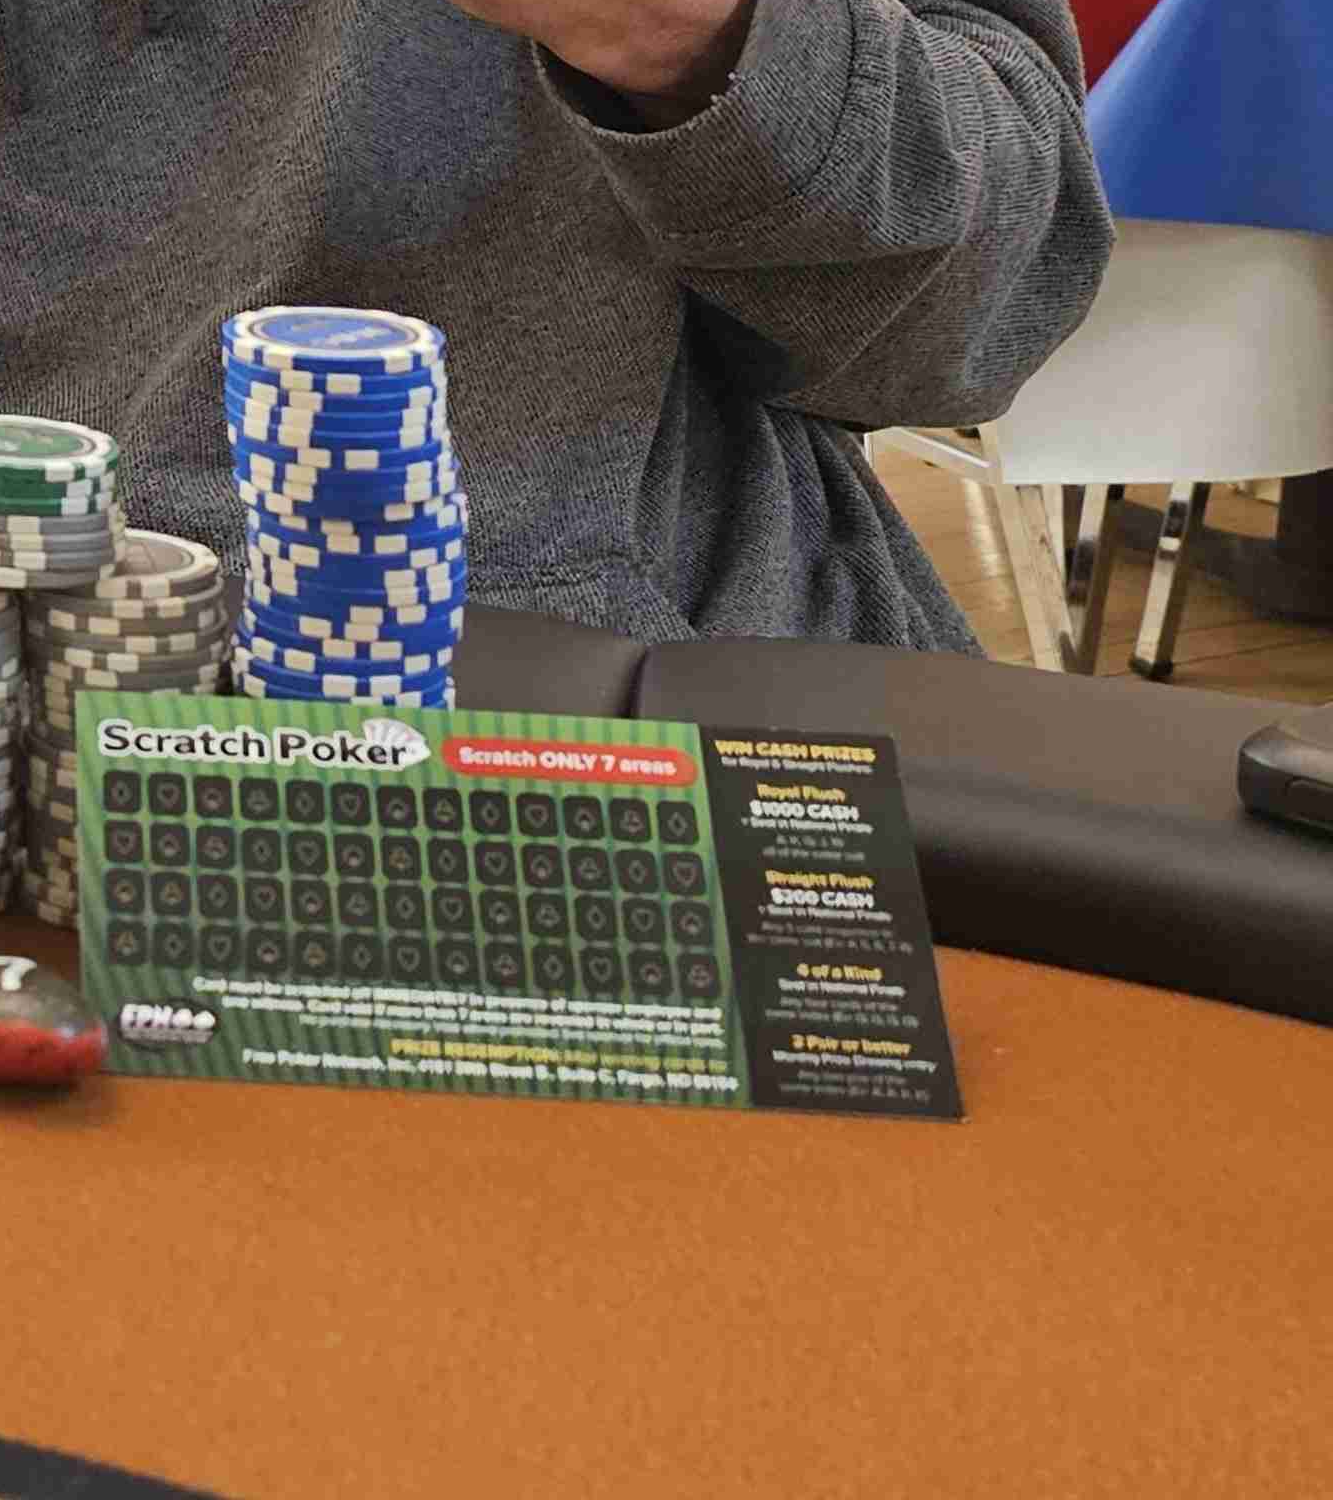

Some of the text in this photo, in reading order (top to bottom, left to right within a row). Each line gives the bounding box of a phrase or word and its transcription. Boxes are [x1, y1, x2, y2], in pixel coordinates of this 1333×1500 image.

[102, 723, 407, 765] Scratch Poker
[755, 741, 809, 759] CASH
[459, 746, 678, 776] Scratch ONLY 7 areas
[807, 803, 860, 821] CASH
[821, 890, 875, 909] CASH
